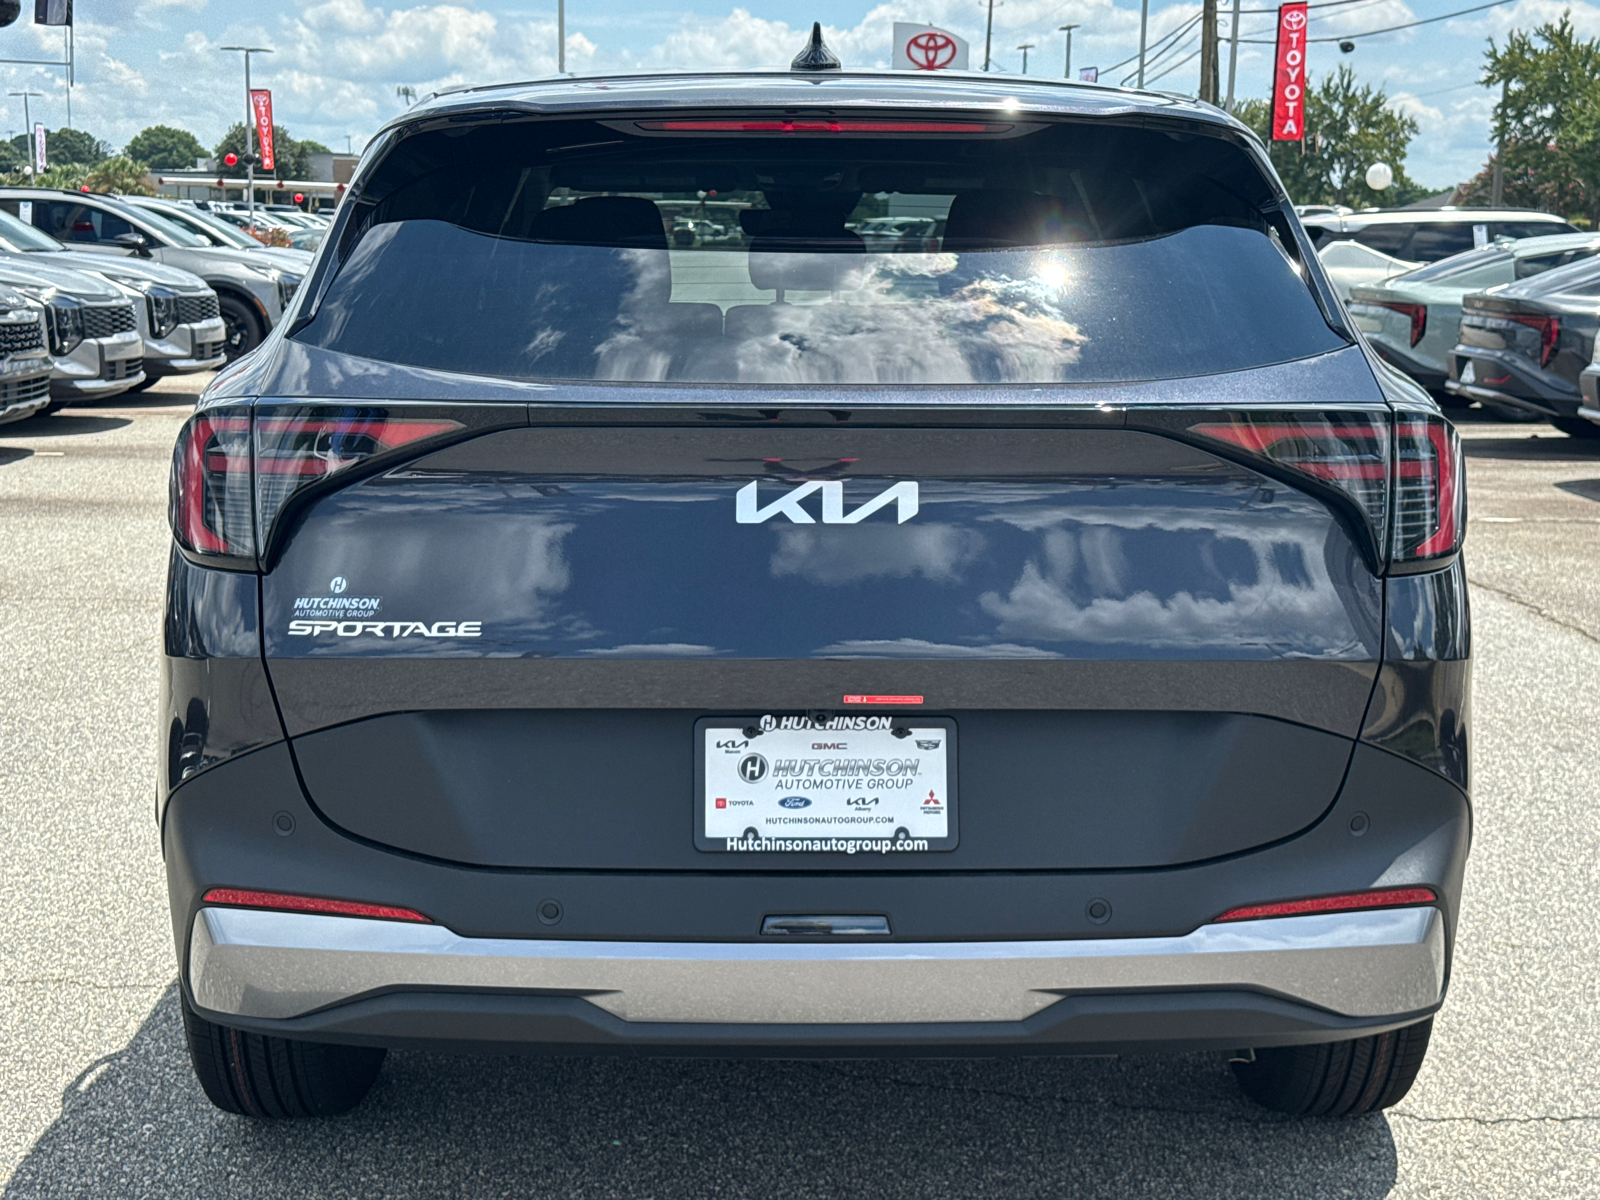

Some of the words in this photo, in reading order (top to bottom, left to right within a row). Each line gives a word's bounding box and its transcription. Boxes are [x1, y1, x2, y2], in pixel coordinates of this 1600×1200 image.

[1282, 32, 1302, 135] TOYOTA
[258, 106, 271, 166] TOYOTA
[735, 479, 919, 525] KIA
[293, 597, 380, 610] HUTCHINSON
[293, 609, 345, 619] AUTOMOTIVE
[346, 610, 375, 618] GROUP
[287, 620, 483, 638] SPORTAGE
[716, 739, 749, 749] KIA
[811, 742, 848, 750] GMC
[772, 758, 920, 777] HUTCHINSON
[774, 778, 863, 790] AUTOMOTIVE
[867, 778, 914, 790] GROUP
[784, 797, 806, 808] Ford
[846, 797, 879, 806] KIA
[765, 816, 895, 825] HUTCHINSONAUTOGROUP.COM
[726, 837, 928, 854] Hutchinsonautogroup.com
